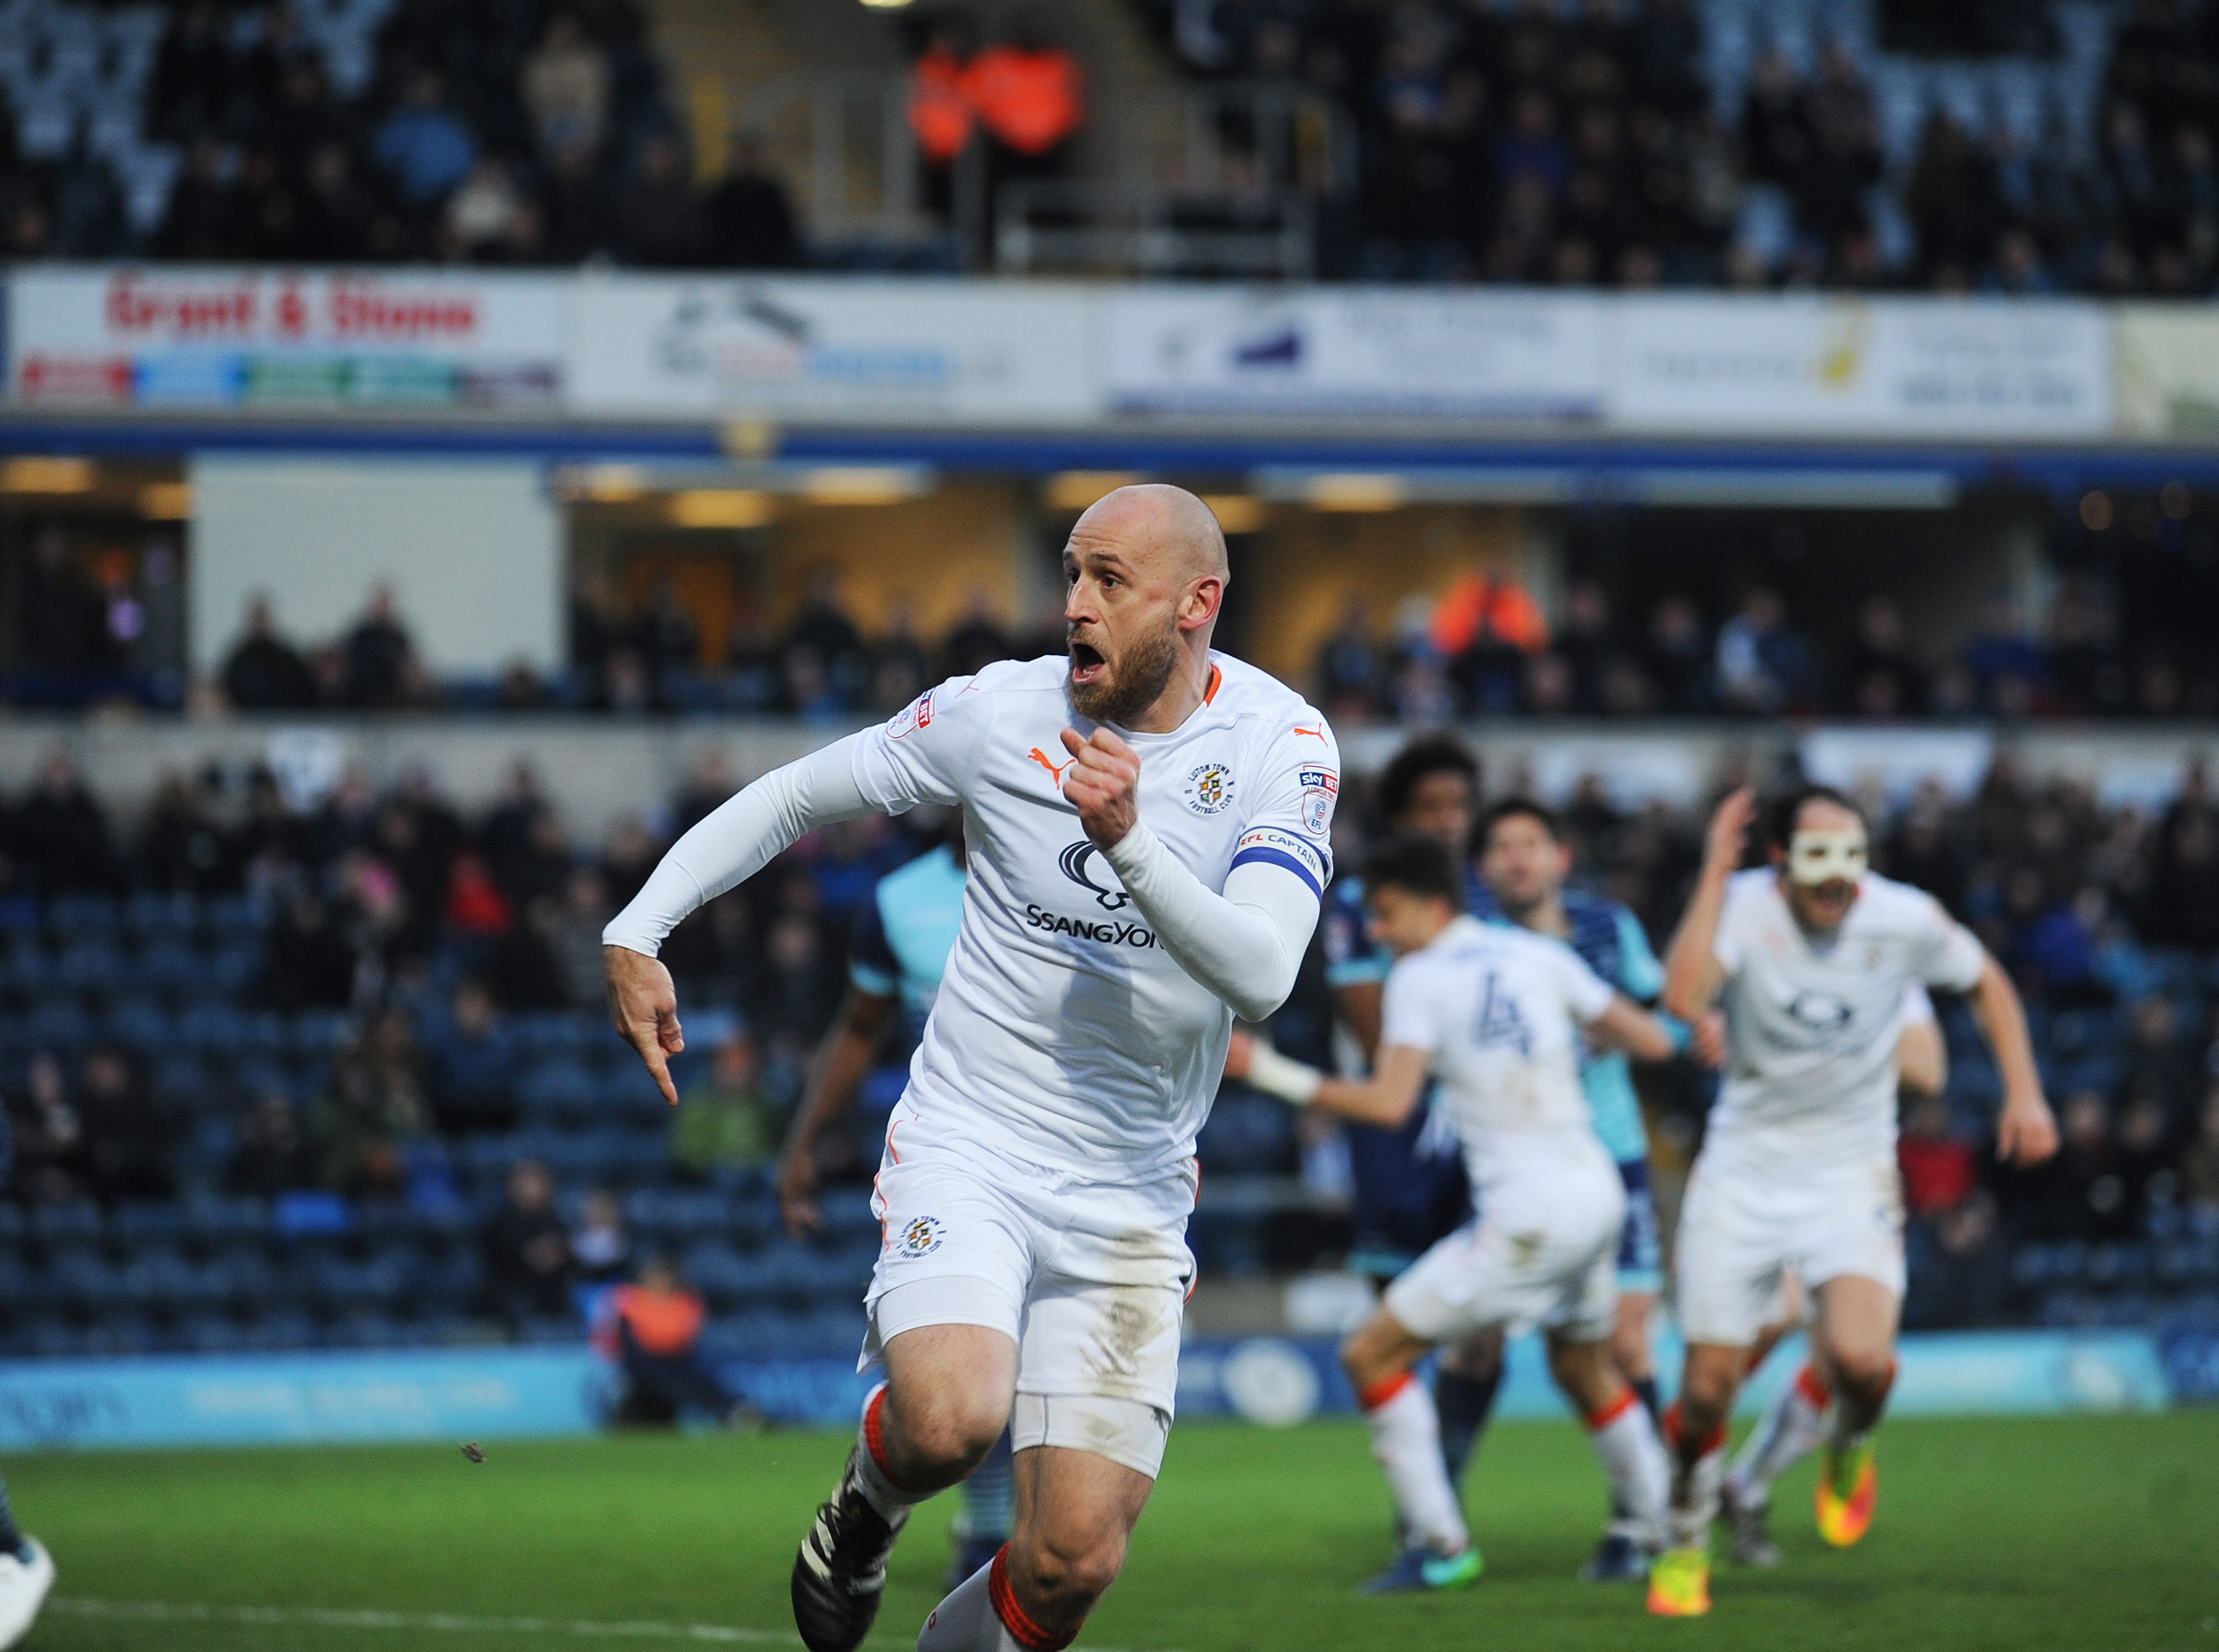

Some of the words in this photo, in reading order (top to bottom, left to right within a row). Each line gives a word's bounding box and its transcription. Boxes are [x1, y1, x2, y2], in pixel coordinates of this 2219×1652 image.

[1188, 764, 1210, 781] LUTON
[1213, 763, 1230, 776] TOWN
[1189, 800, 1220, 815] FOOTBALL
[1311, 819, 1322, 830] EFL
[1241, 834, 1264, 845] EFL
[1268, 834, 1316, 870] CAPTAIN
[1473, 973, 1530, 1059] 4
